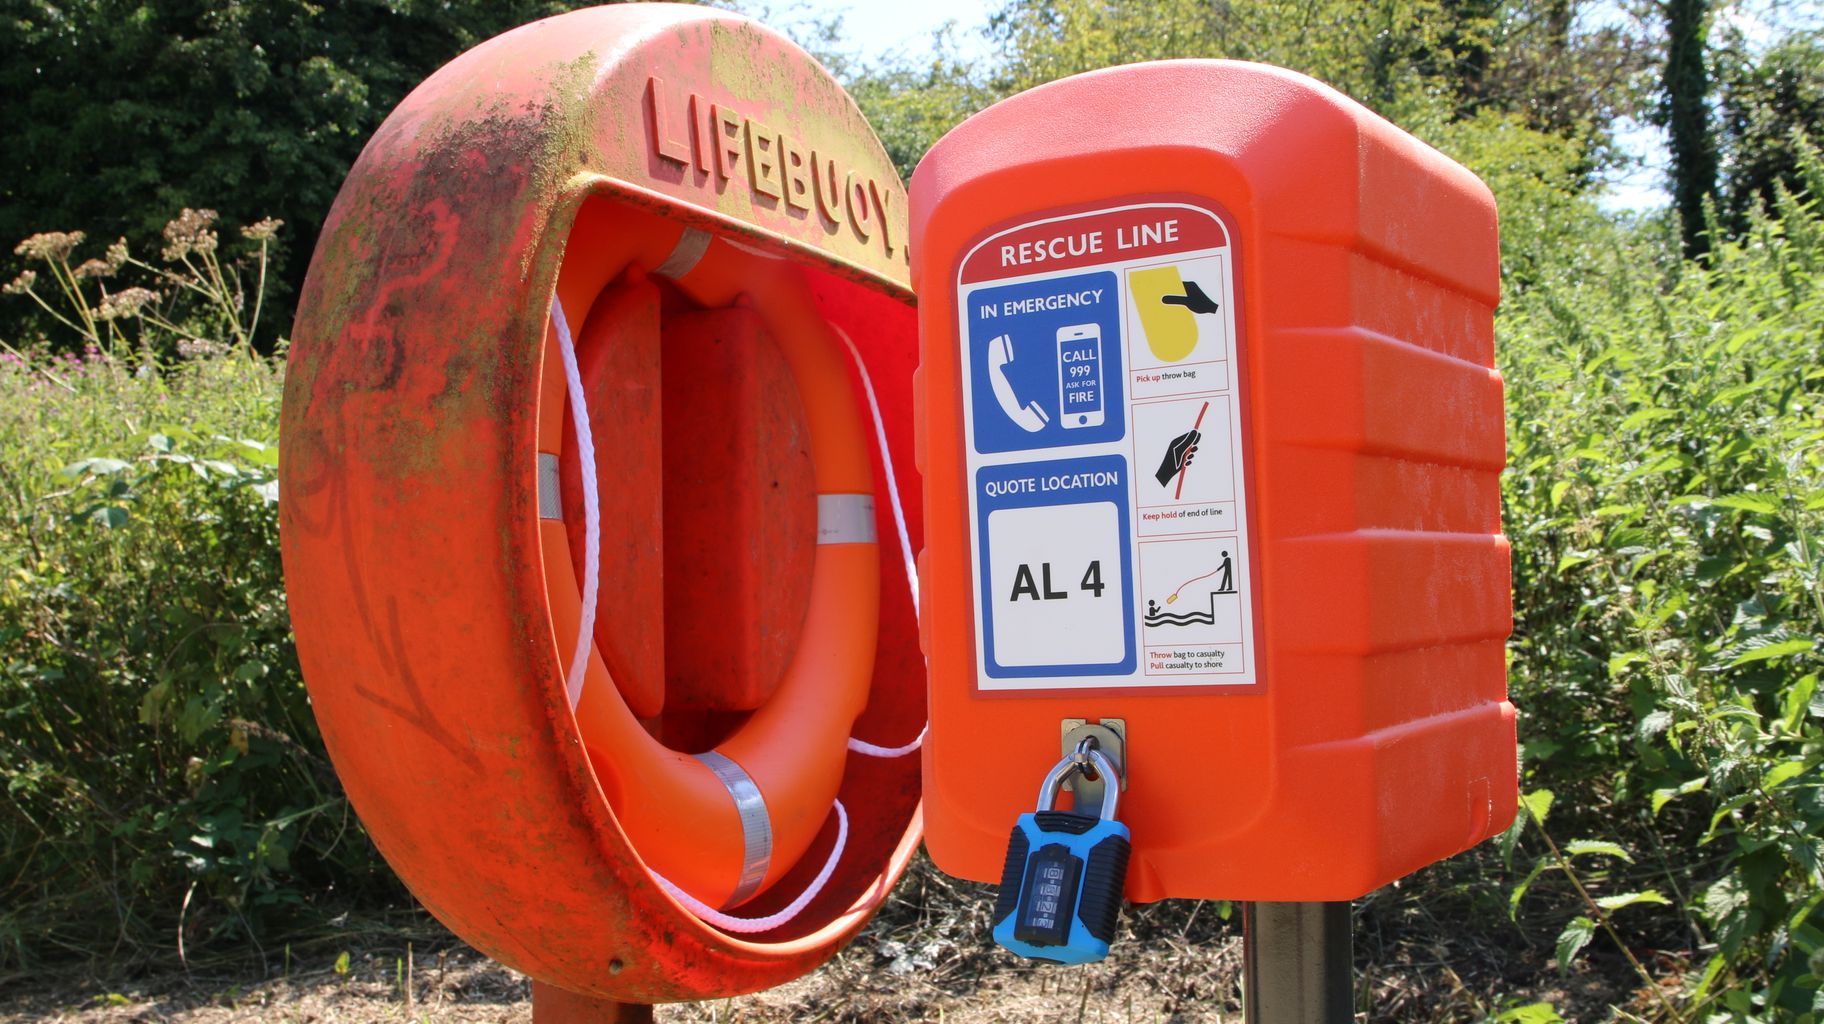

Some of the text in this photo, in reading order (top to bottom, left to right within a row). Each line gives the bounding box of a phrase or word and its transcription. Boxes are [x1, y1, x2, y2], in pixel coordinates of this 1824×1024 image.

[648, 76, 909, 264] LIFEBUOY
[1001, 219, 1179, 267] RESCUE LINE
[980, 289, 1103, 319] IN EMERGENCY
[1062, 349, 1096, 363] CALL
[1069, 365, 1090, 378] 999
[1136, 374, 1150, 382] Pick
[1162, 372, 1182, 380] throw
[1183, 370, 1196, 378] bag
[1065, 379, 1096, 389] ASK FOR
[1069, 391, 1094, 403] FIRE
[985, 471, 1118, 498] QUOTE LOCATION
[1142, 508, 1223, 521] Keep hold of end of line
[1009, 560, 1105, 602] AL 4
[1150, 651, 1172, 659] Throw
[1173, 650, 1186, 660] bag
[1196, 649, 1225, 658] casualty
[1165, 661, 1193, 670] casualty
[1203, 660, 1223, 668] shore
